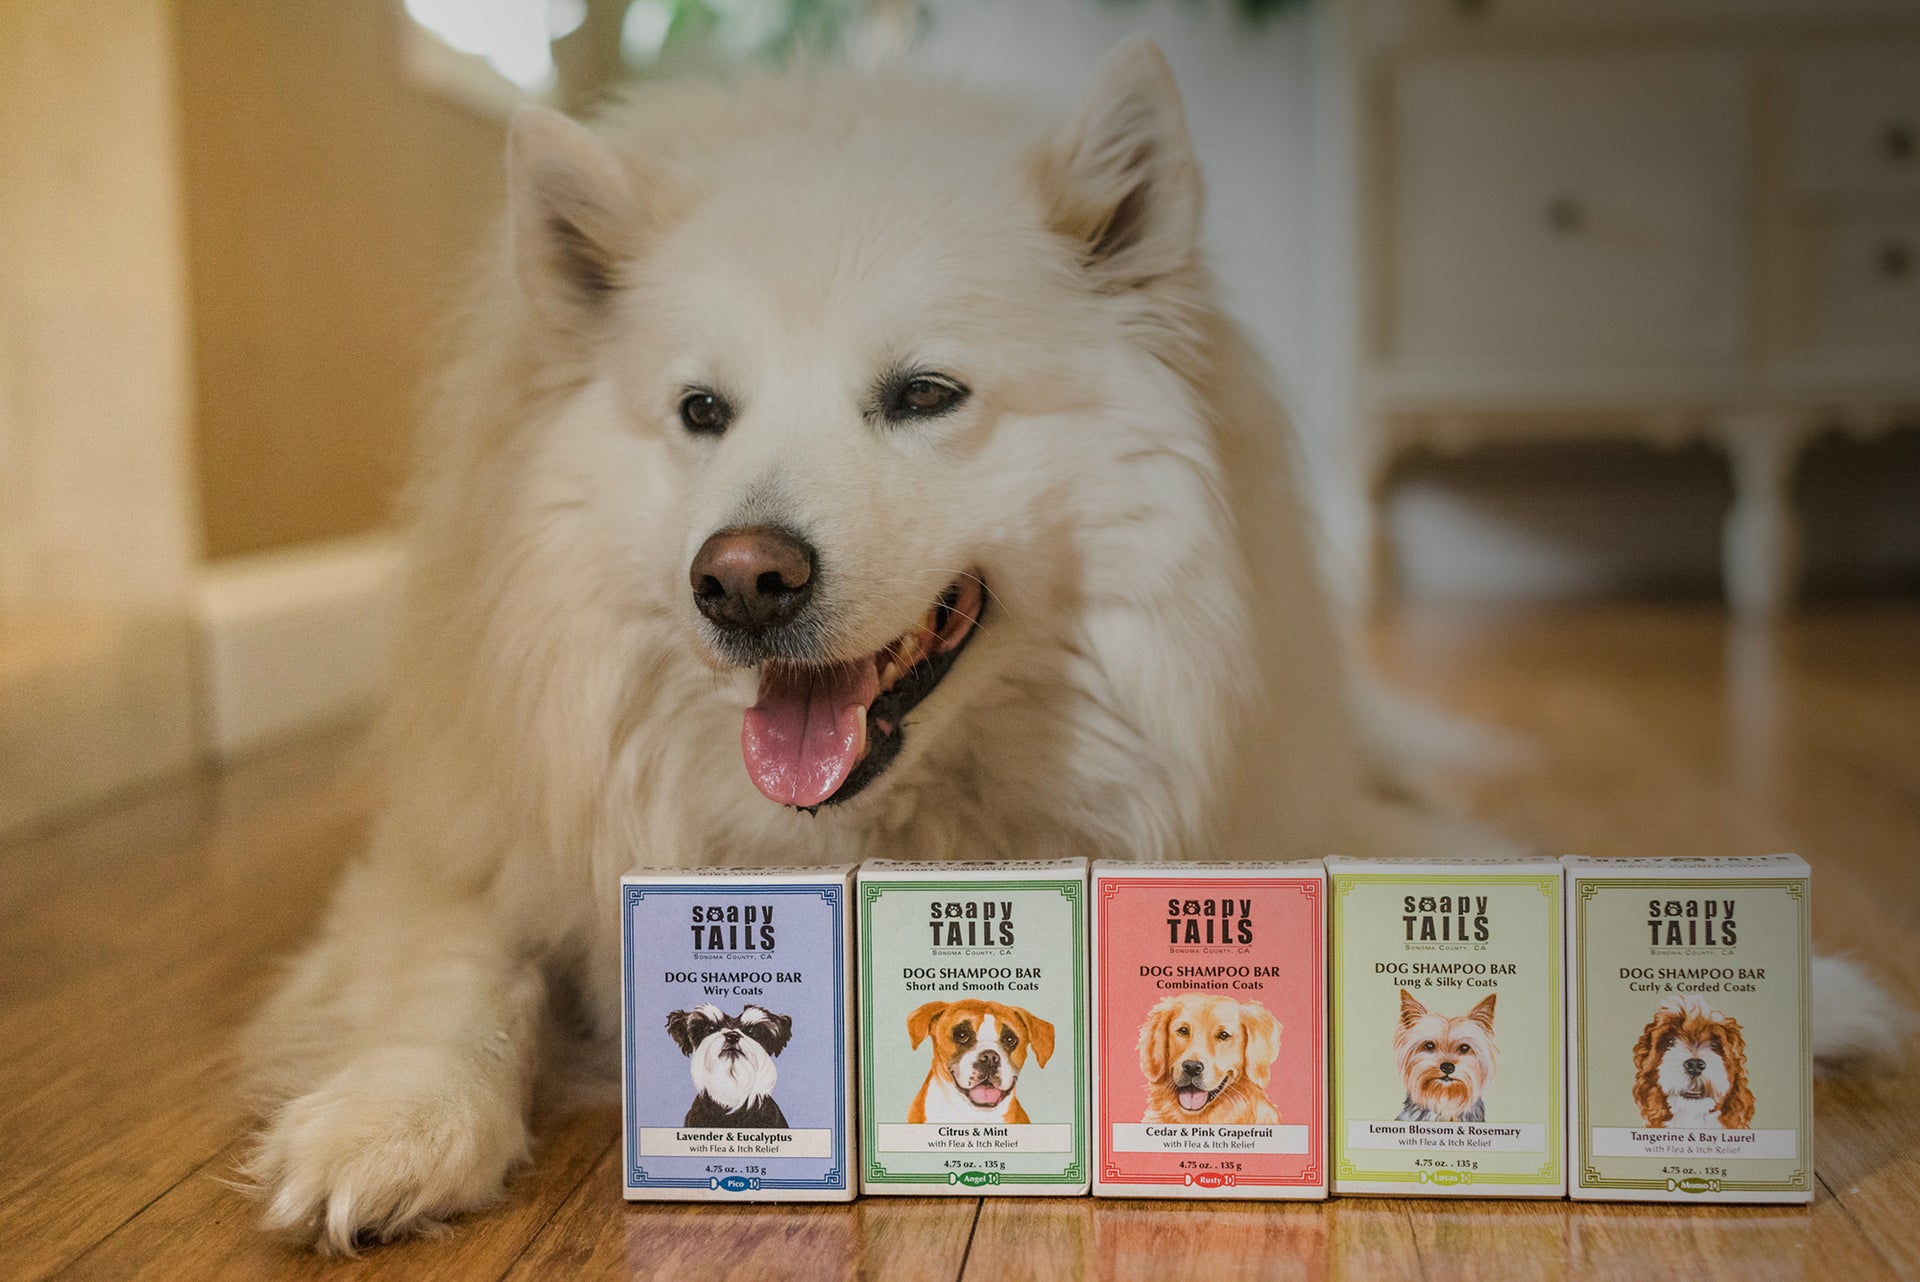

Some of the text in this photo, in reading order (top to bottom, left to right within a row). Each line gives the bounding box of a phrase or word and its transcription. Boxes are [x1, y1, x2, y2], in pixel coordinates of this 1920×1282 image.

[930, 921, 1014, 946] TAILS
[1167, 919, 1253, 944] TAILS
[1403, 916, 1489, 941] TAILS
[1648, 920, 1737, 946] TAILS
[691, 925, 775, 950] TAILS
[903, 968, 1041, 979] DOG SHAMPOO BAR
[1140, 966, 1280, 977] DOG SHAMPOO BAR
[1375, 963, 1517, 974] DOG SHAMPOO BAR
[1620, 968, 1765, 979] DOG SHAMPOO BAR
[665, 972, 802, 983] DOG SHAMPOO BAR
[1394, 977, 1498, 989] Long & Silky Coats
[906, 981, 1039, 991] Short and Smooth Coats
[1157, 980, 1264, 989] Combination Coats
[1630, 982, 1756, 994] Curly & Corded Coats
[704, 986, 763, 997] Wiry Coats
[938, 1127, 1008, 1137] Citrus & Mint
[1146, 1127, 1273, 1140] Cedar & Pink Grapefruit
[1370, 1124, 1521, 1137] Lemon Blossom & Rosemary
[677, 1132, 792, 1143] Lavender & Eucalyptus
[1439, 1139, 1446, 1147] &
[1448, 1139, 1464, 1147] Itch
[1467, 1139, 1492, 1147] Relief
[1631, 1131, 1755, 1144] Tangerine & Bay Laurel
[689, 1145, 707, 1153] with
[710, 1145, 727, 1153] Flea
[737, 1145, 753, 1153] Itch
[755, 1145, 779, 1153] Relief
[928, 1140, 946, 1148] with
[948, 1140, 965, 1148] Flea
[976, 1140, 992, 1148] Itch
[994, 1140, 1018, 1148] Relief
[1163, 1140, 1255, 1149] with Flea & Itch Relief
[1645, 1145, 1741, 1154] with Flea & Itch Relief
[705, 1165, 722, 1173] 4.75
[745, 1165, 759, 1173] 135
[761, 1167, 766, 1175] g
[944, 1160, 961, 1168] 4.75
[985, 1160, 998, 1168] 135
[1000, 1162, 1005, 1170] g
[1180, 1161, 1197, 1169] 4.75
[1236, 1163, 1242, 1171] g
[1472, 1161, 1478, 1169] g
[1662, 1166, 1680, 1174] 4.75
[1721, 1168, 1727, 1176] g
[963, 1175, 986, 1184] Angel
[1200, 1177, 1221, 1185] Rusty
[1681, 1181, 1708, 1189] Momo
